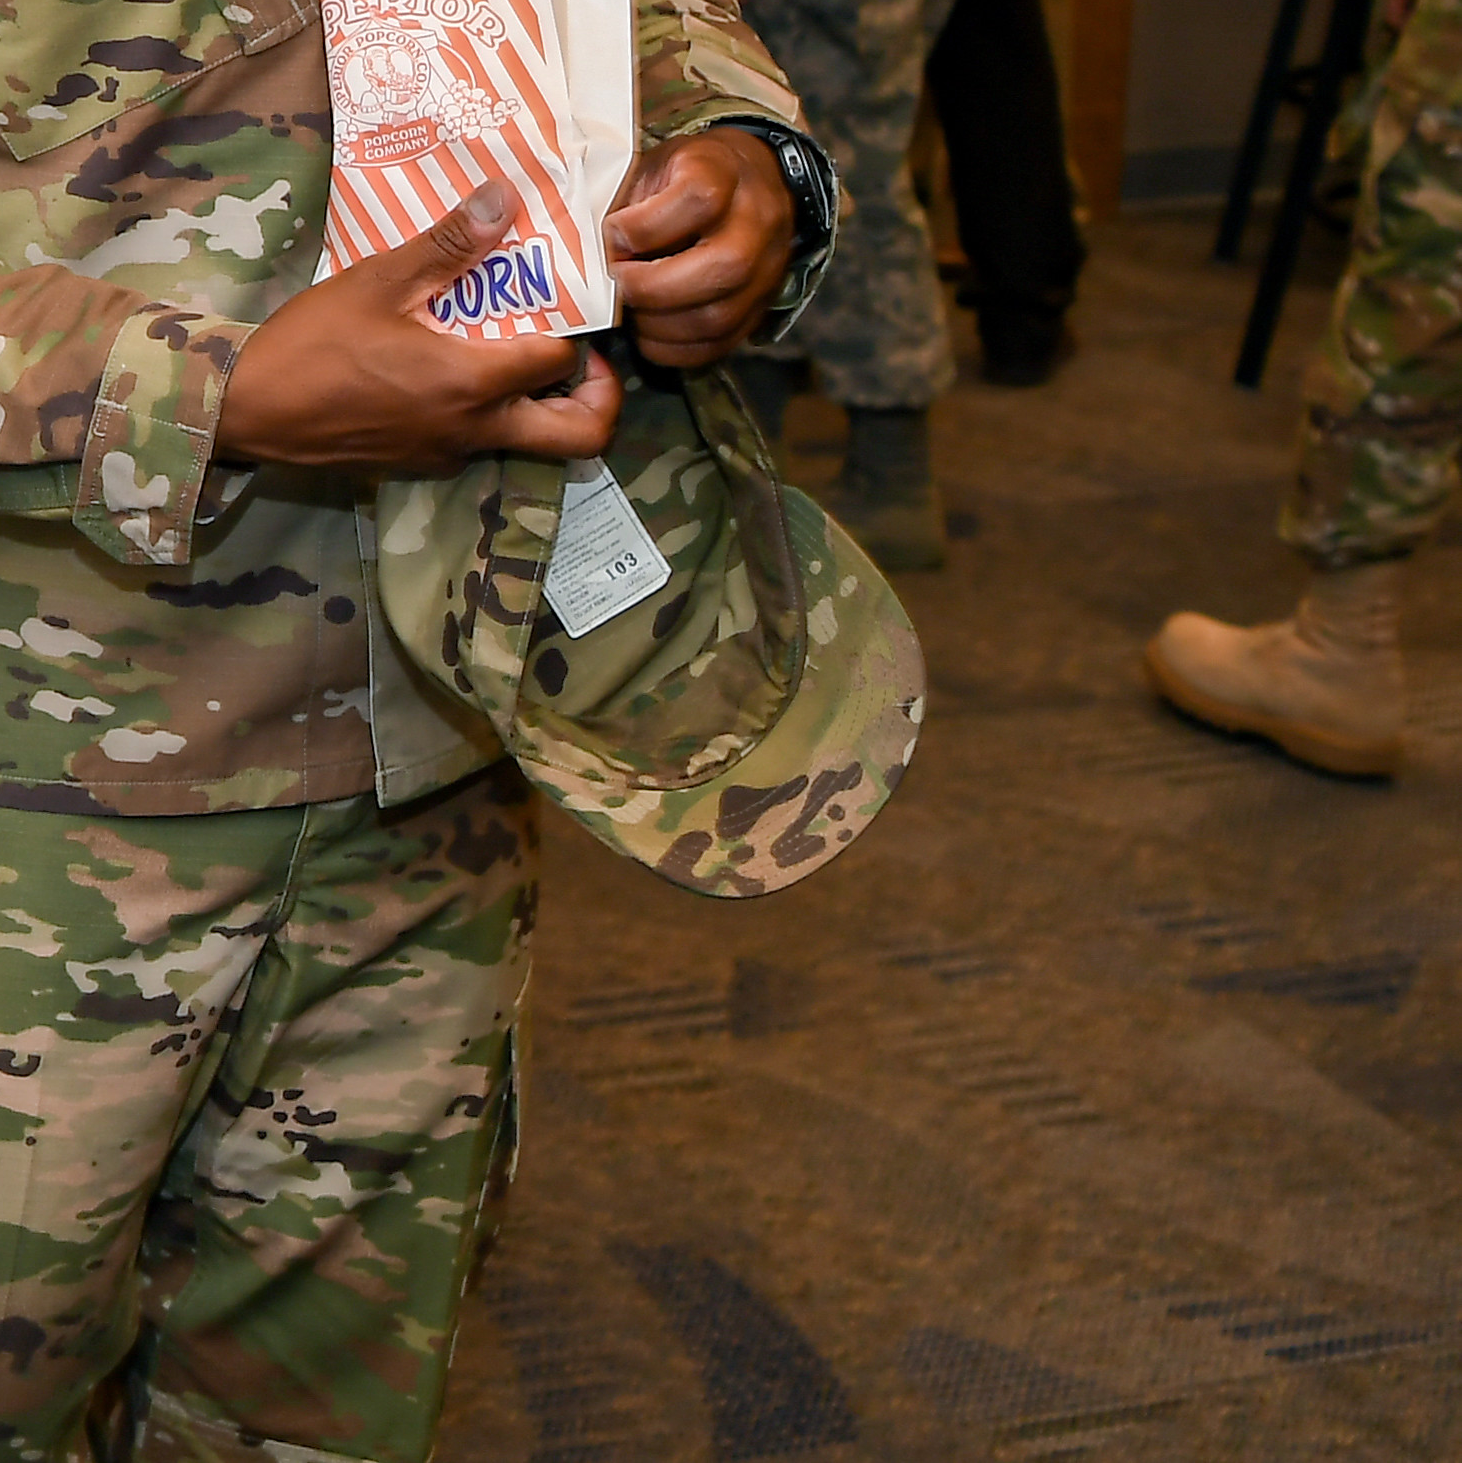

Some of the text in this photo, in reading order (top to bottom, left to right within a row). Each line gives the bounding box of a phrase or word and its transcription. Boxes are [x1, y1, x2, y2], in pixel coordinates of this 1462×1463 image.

[364, 125, 428, 149] POPCORN
[364, 137, 429, 160] COMPANY
[427, 243, 553, 324] CORN
[605, 553, 637, 580] 103
